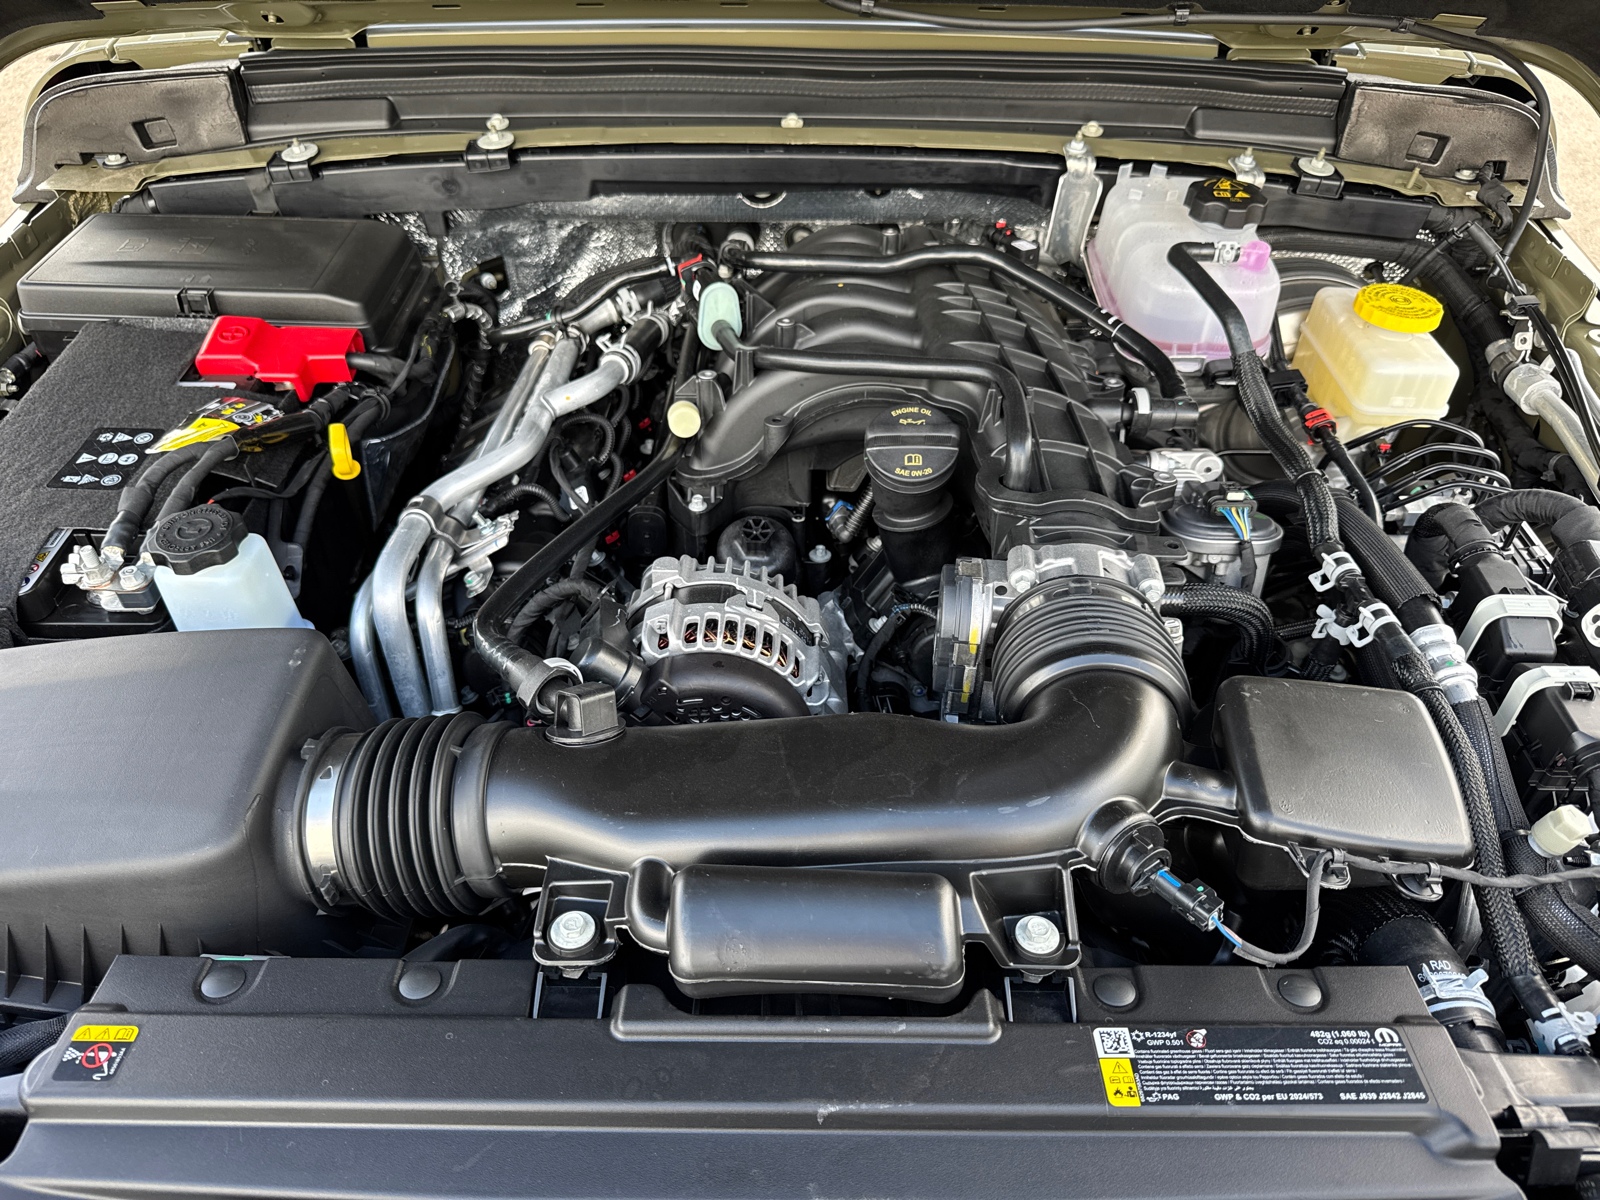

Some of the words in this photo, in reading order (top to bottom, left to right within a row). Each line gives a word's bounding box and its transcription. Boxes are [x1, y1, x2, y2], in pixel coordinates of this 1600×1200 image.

[891, 407, 919, 417] ENGINE
[920, 407, 932, 417] OIL
[894, 467, 910, 477] SAE
[911, 467, 933, 477] 0W-20
[1429, 960, 1452, 971] RAD
[1145, 1031, 1177, 1039] R-1234yf
[1162, 1093, 1180, 1101] PAG
[1214, 1093, 1234, 1101] GWP
[1235, 1093, 1242, 1101] &
[1243, 1093, 1260, 1101] CO2
[1262, 1094, 1275, 1102] per
[1289, 1092, 1324, 1100] 2024/573
[1339, 1092, 1358, 1100] SAE
